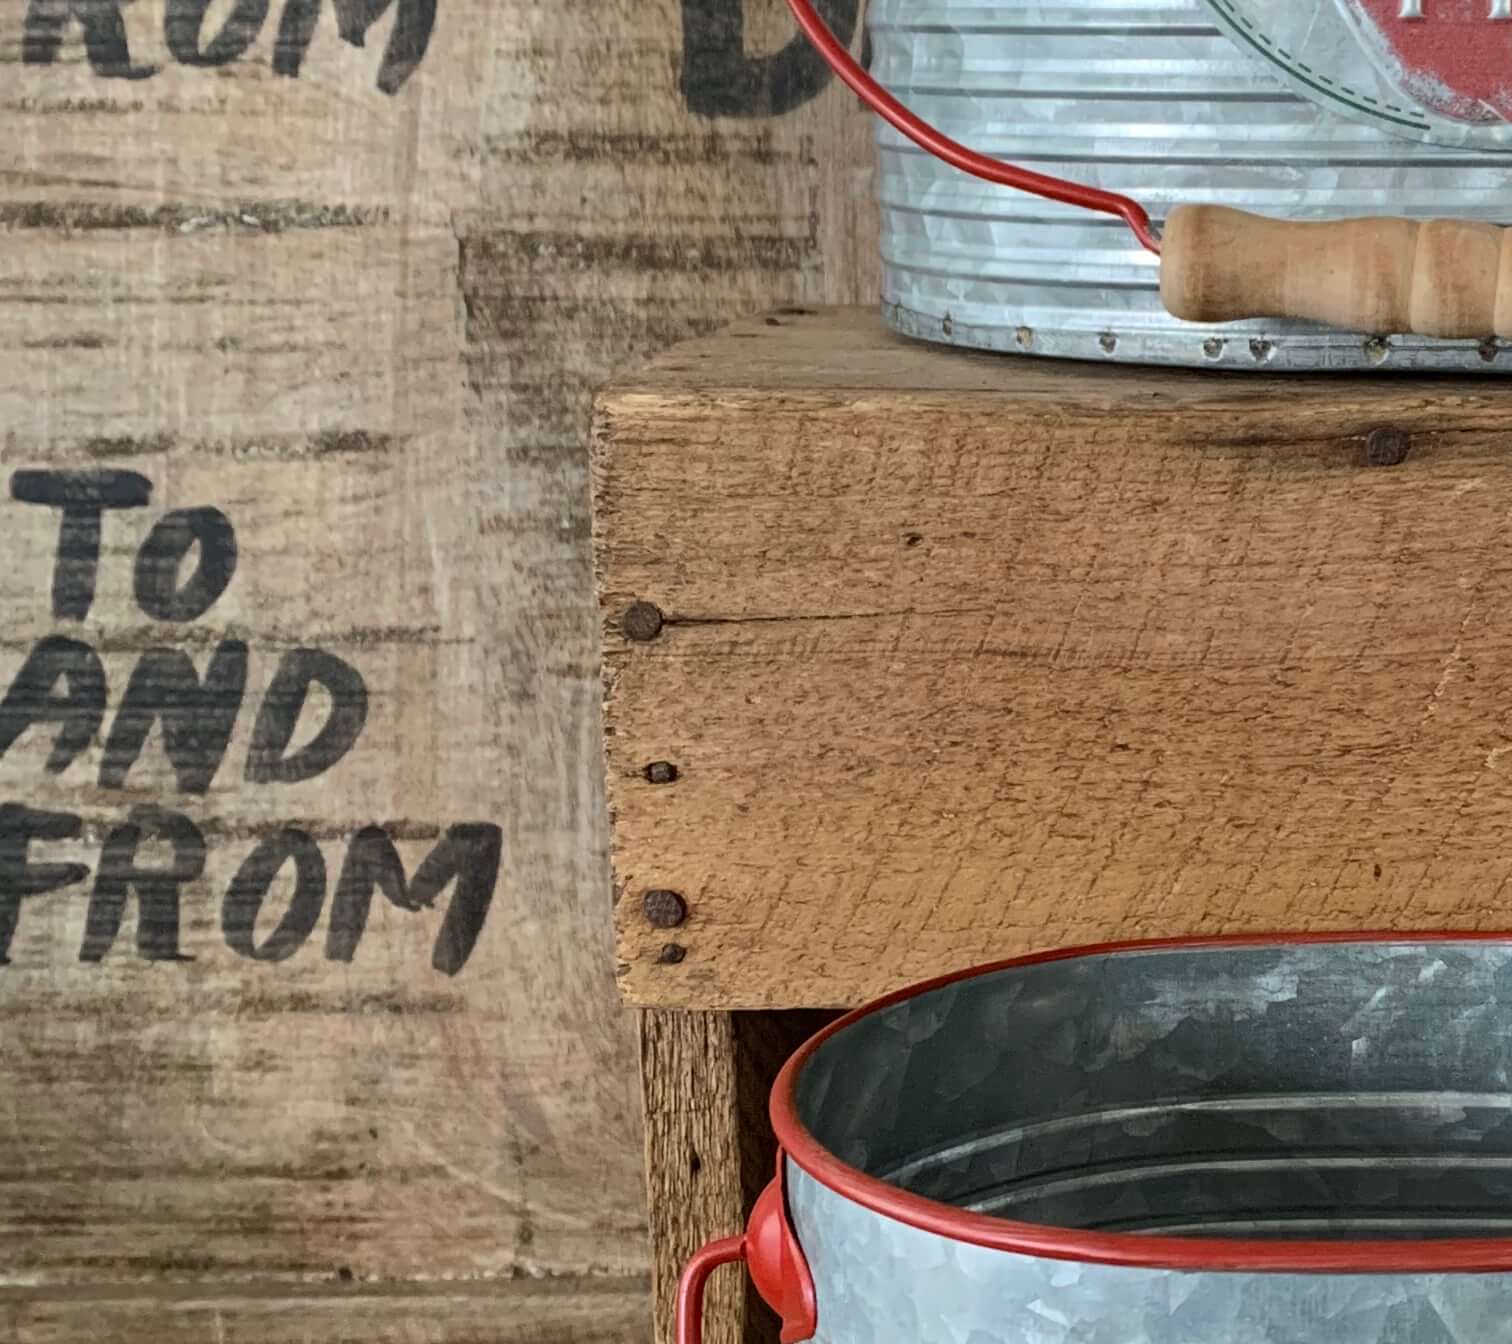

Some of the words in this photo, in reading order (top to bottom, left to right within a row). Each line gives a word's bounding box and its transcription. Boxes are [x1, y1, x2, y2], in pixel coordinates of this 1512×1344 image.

[10, 469, 239, 622] TO
[0, 635, 368, 795] AND
[0, 803, 502, 976] FROM
